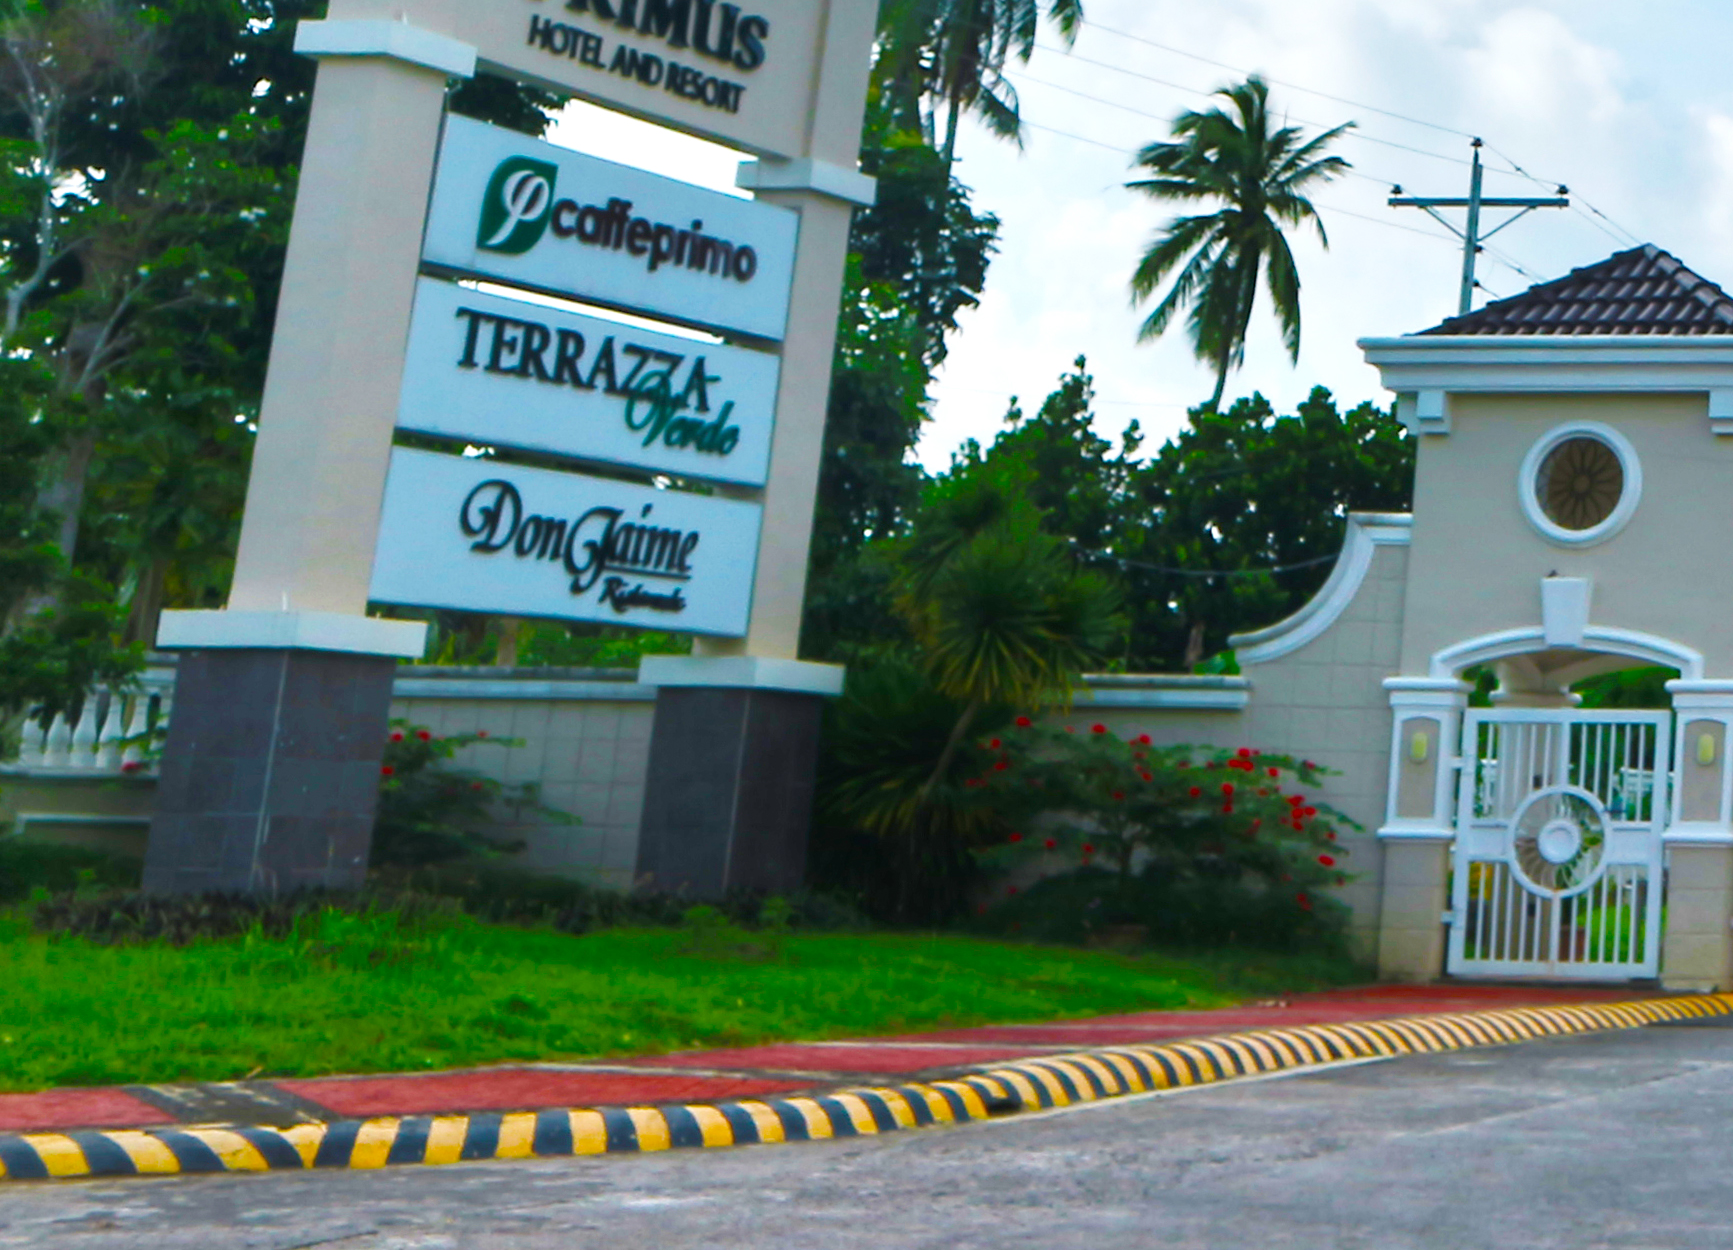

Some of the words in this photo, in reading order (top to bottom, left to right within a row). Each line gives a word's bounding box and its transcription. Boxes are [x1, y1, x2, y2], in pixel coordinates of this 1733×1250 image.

[527, 13, 606, 70] HOTEL
[609, 44, 664, 86] AND
[664, 62, 747, 114] RESORT
[551, 196, 757, 282] caffeprimo
[456, 307, 721, 413] TERRAZZA
[460, 479, 567, 560] Don
